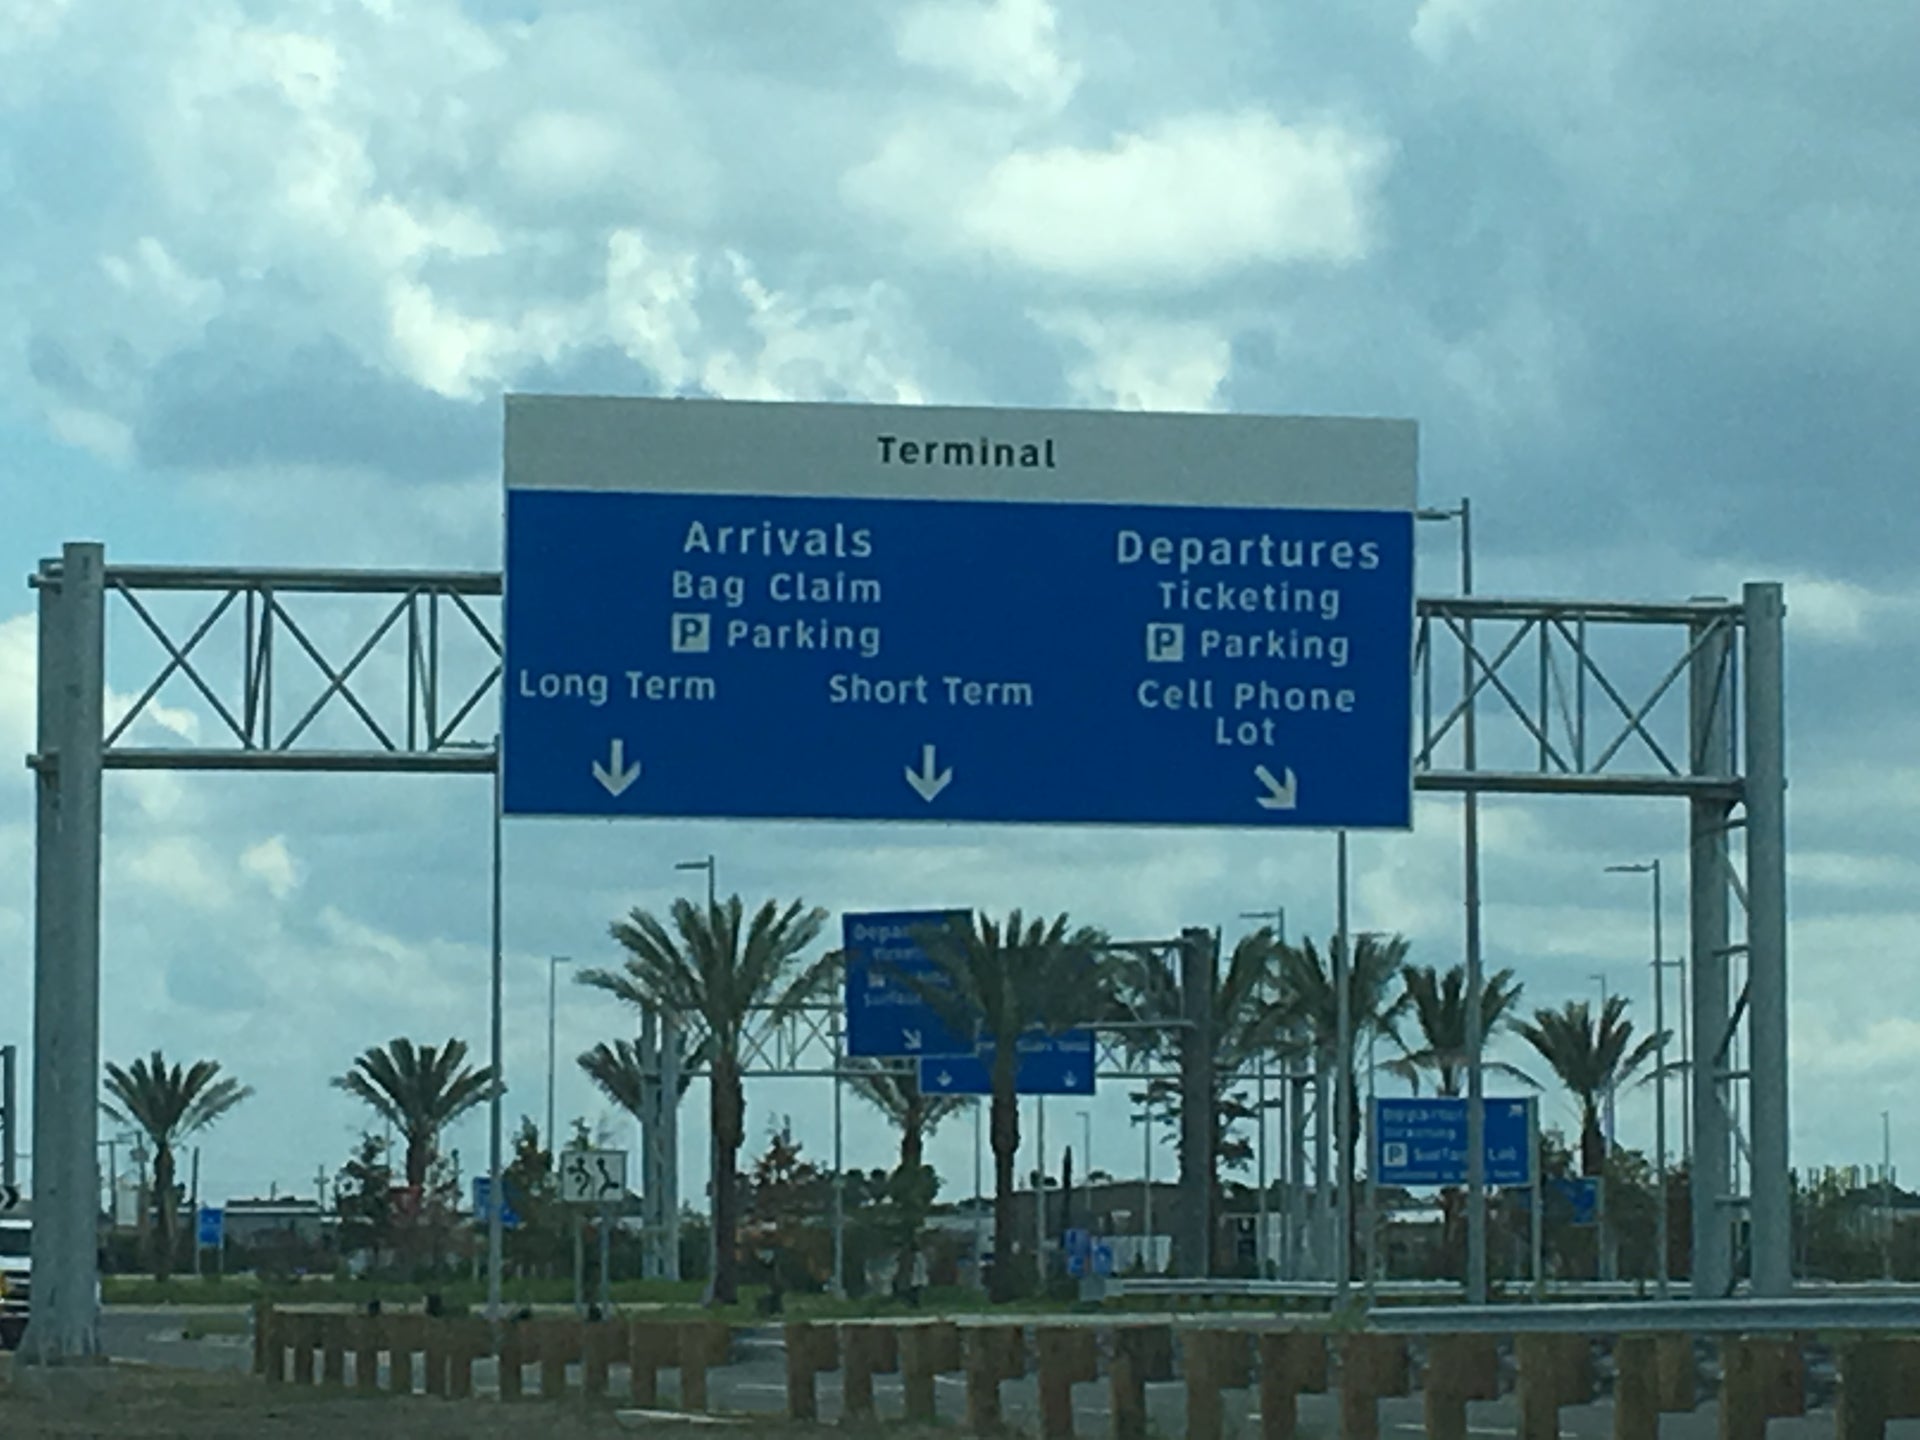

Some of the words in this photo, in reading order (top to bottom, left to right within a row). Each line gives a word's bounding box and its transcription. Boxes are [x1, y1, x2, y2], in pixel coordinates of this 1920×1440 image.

[877, 436, 1057, 469] Terminal
[683, 520, 873, 558] Arrivals
[1116, 530, 1381, 574] Departures
[672, 570, 745, 608] Bag
[769, 571, 882, 604] Claim
[1159, 580, 1341, 620] Ticketing
[677, 616, 706, 650] P
[727, 618, 881, 659] Parking
[1151, 626, 1179, 659] P
[1200, 629, 1350, 668] Parking
[519, 669, 608, 707] Long
[625, 670, 717, 701] Term
[828, 674, 928, 705] Short
[942, 675, 1034, 708] Term
[1137, 679, 1214, 710] Cell
[1234, 680, 1357, 713] Phone
[1215, 716, 1276, 747] Lot
